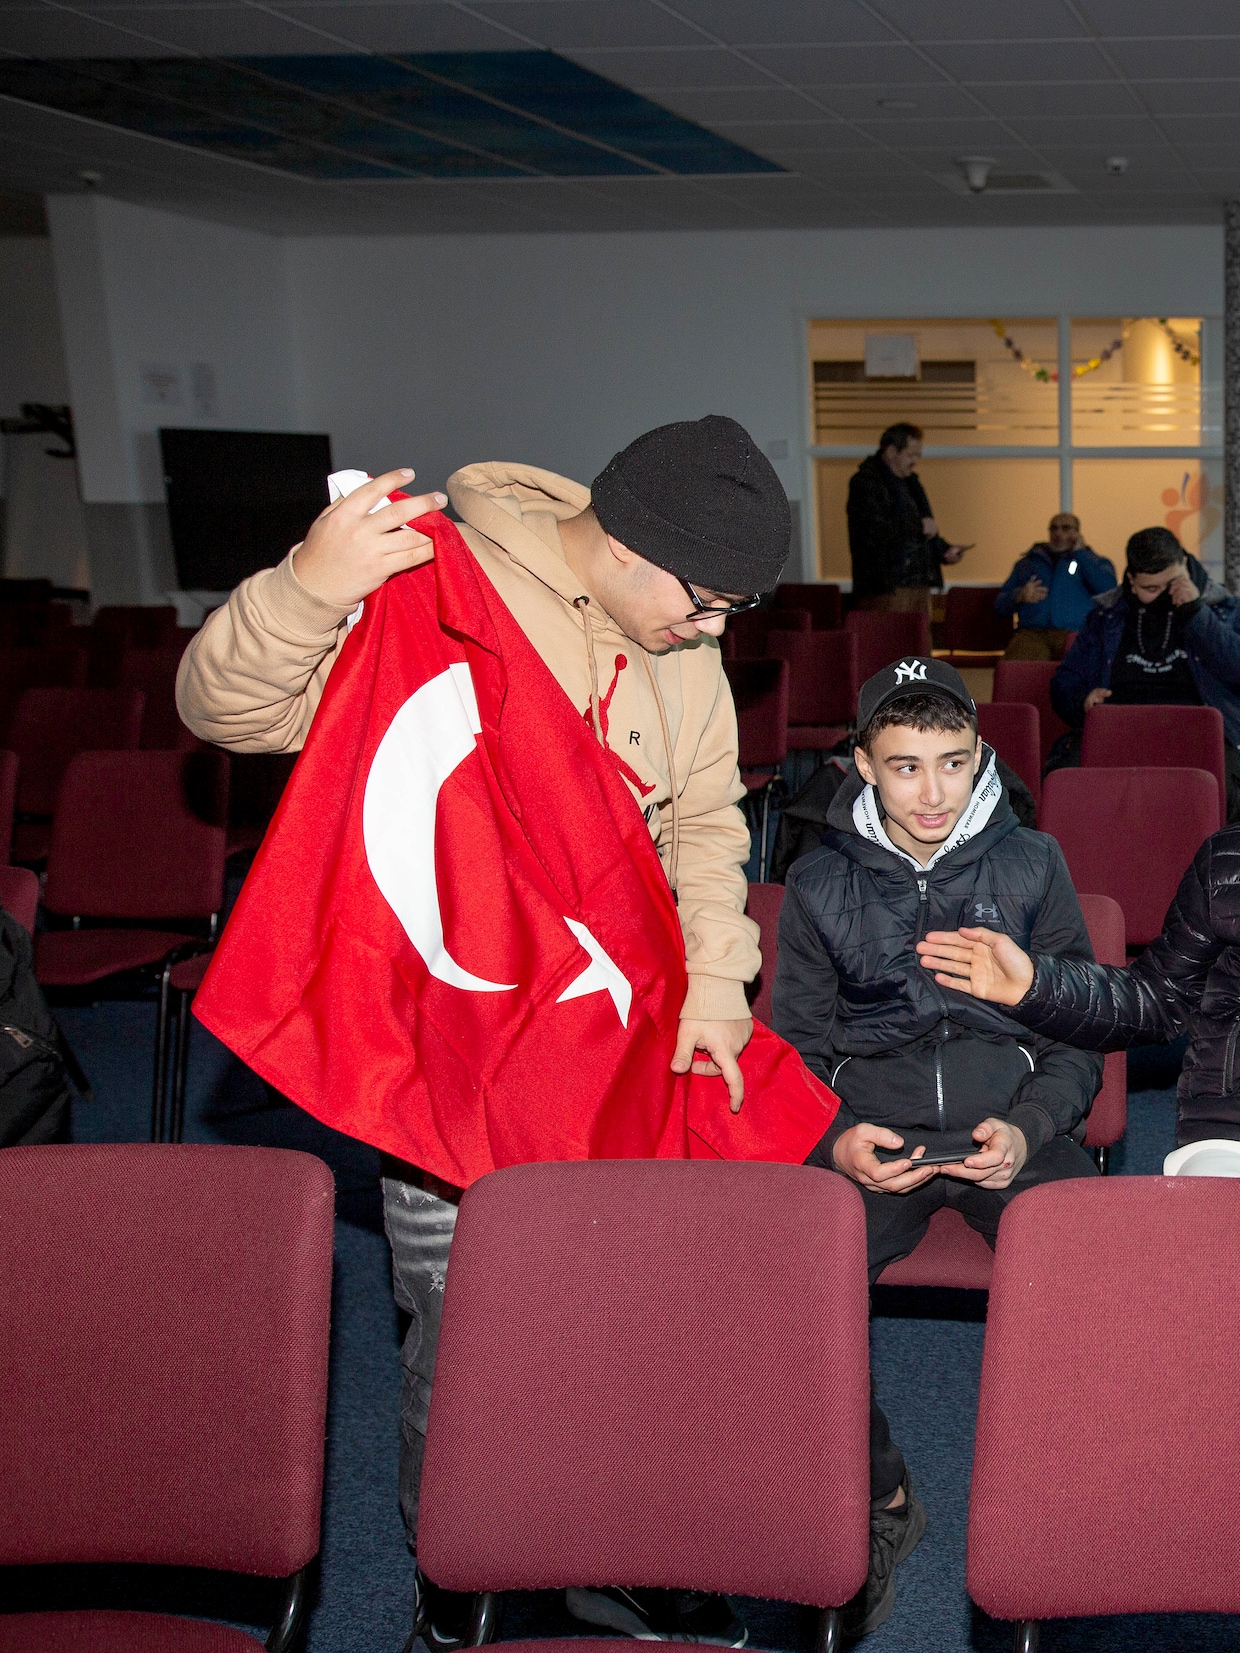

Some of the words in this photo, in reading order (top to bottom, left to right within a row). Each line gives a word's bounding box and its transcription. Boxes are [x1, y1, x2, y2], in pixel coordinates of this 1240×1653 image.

[894, 659, 928, 685] NY
[629, 730, 641, 746] R
[964, 801, 980, 829] HOMEWEAR
